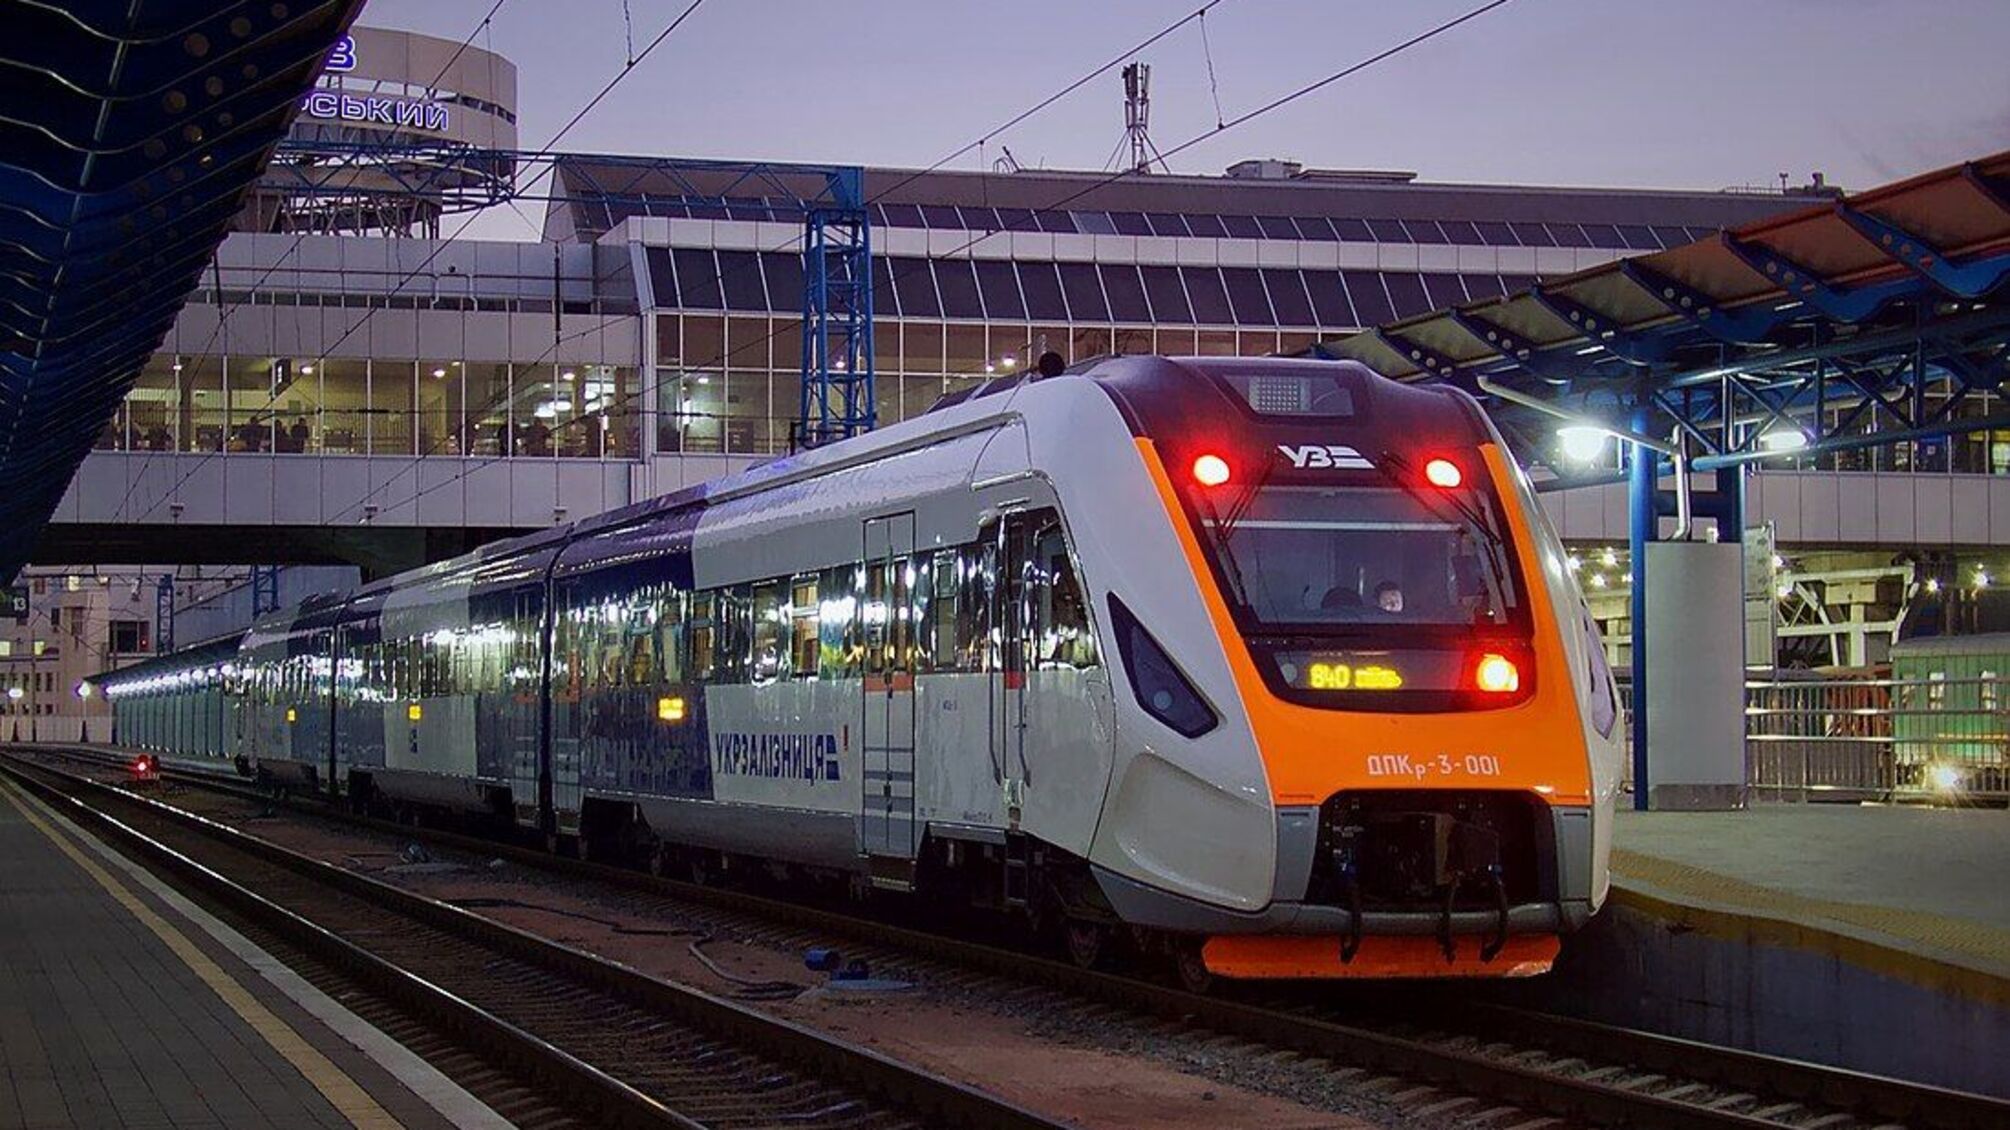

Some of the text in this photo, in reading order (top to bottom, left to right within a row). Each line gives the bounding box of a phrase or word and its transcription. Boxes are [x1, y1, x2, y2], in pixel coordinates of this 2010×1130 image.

[302, 93, 449, 131] СЬКИЙ
[1278, 445, 1333, 468] УЗ
[715, 733, 825, 787] УКРЗАЛІЗНИЦЯ
